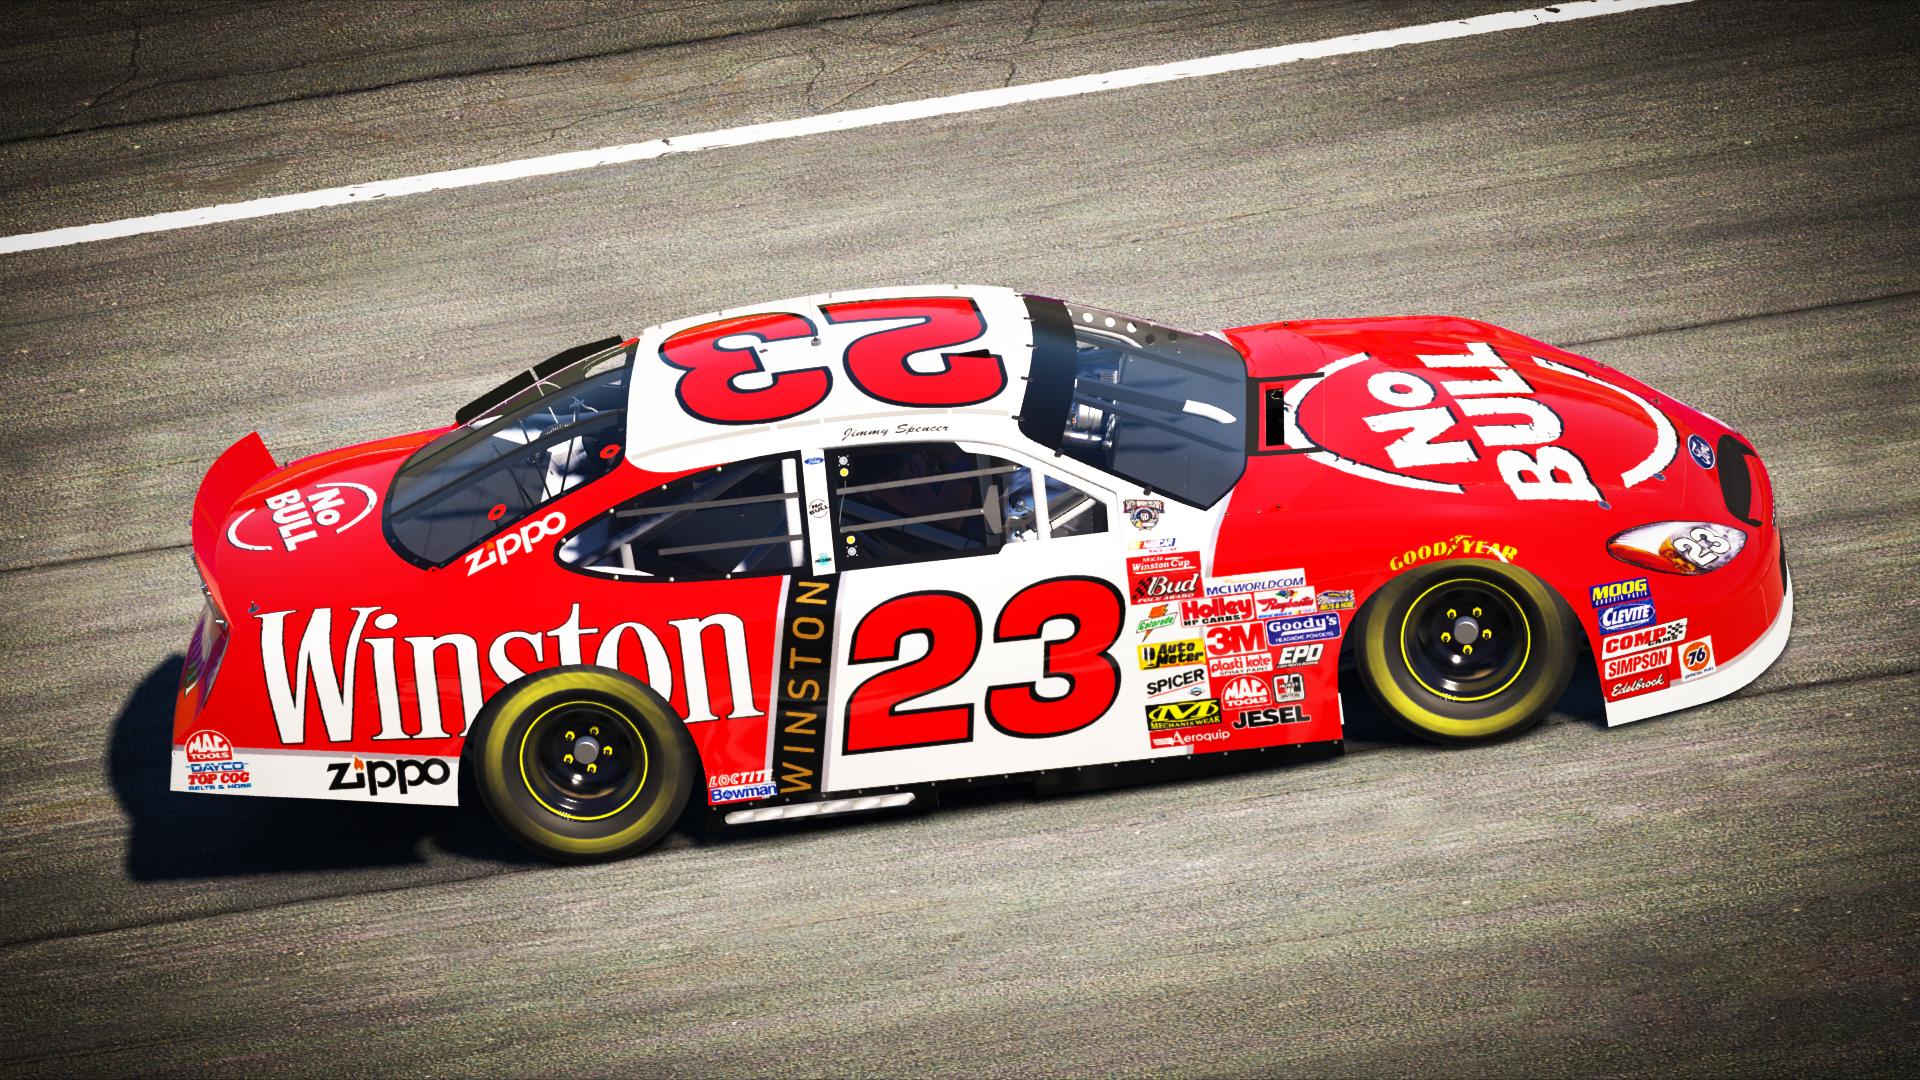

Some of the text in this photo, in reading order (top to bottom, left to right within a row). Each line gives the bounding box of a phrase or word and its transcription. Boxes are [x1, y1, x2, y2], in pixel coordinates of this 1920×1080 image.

[658, 296, 1008, 425] 23
[1417, 342, 1605, 501] BULL
[842, 424, 949, 441] Jimmy Spencer
[265, 489, 318, 551] BULL
[1673, 527, 1731, 566] 23
[1132, 559, 1190, 571] Winston Cup
[1147, 573, 1200, 596] Bud
[1593, 579, 1647, 601] MOOG
[1181, 597, 1252, 620] Holley
[1202, 614, 1241, 625] CARBS
[1268, 615, 1338, 635] Goody's
[1158, 642, 1196, 655] Auto
[1207, 622, 1264, 656] 3M
[1605, 627, 1667, 653] COMP
[842, 575, 1126, 756] 23
[1156, 652, 1204, 665] Meter
[1211, 658, 1243, 673] plasti
[1246, 656, 1271, 669] kote
[1608, 649, 1668, 677] SIMPSON
[1688, 647, 1706, 665] 76
[779, 581, 830, 794] WINSTON
[1147, 669, 1205, 695] SPICER
[1611, 674, 1665, 696] Edelbrock
[1226, 697, 1268, 707] TOOLS
[1232, 705, 1312, 729] JESEL
[1171, 729, 1231, 746] Aeroquip
[190, 751, 230, 760] TOOLS
[188, 761, 246, 773] DAYCO
[187, 771, 250, 785] TOP COG
[709, 769, 774, 788] LOCTITE
[710, 783, 778, 803] Bowman
